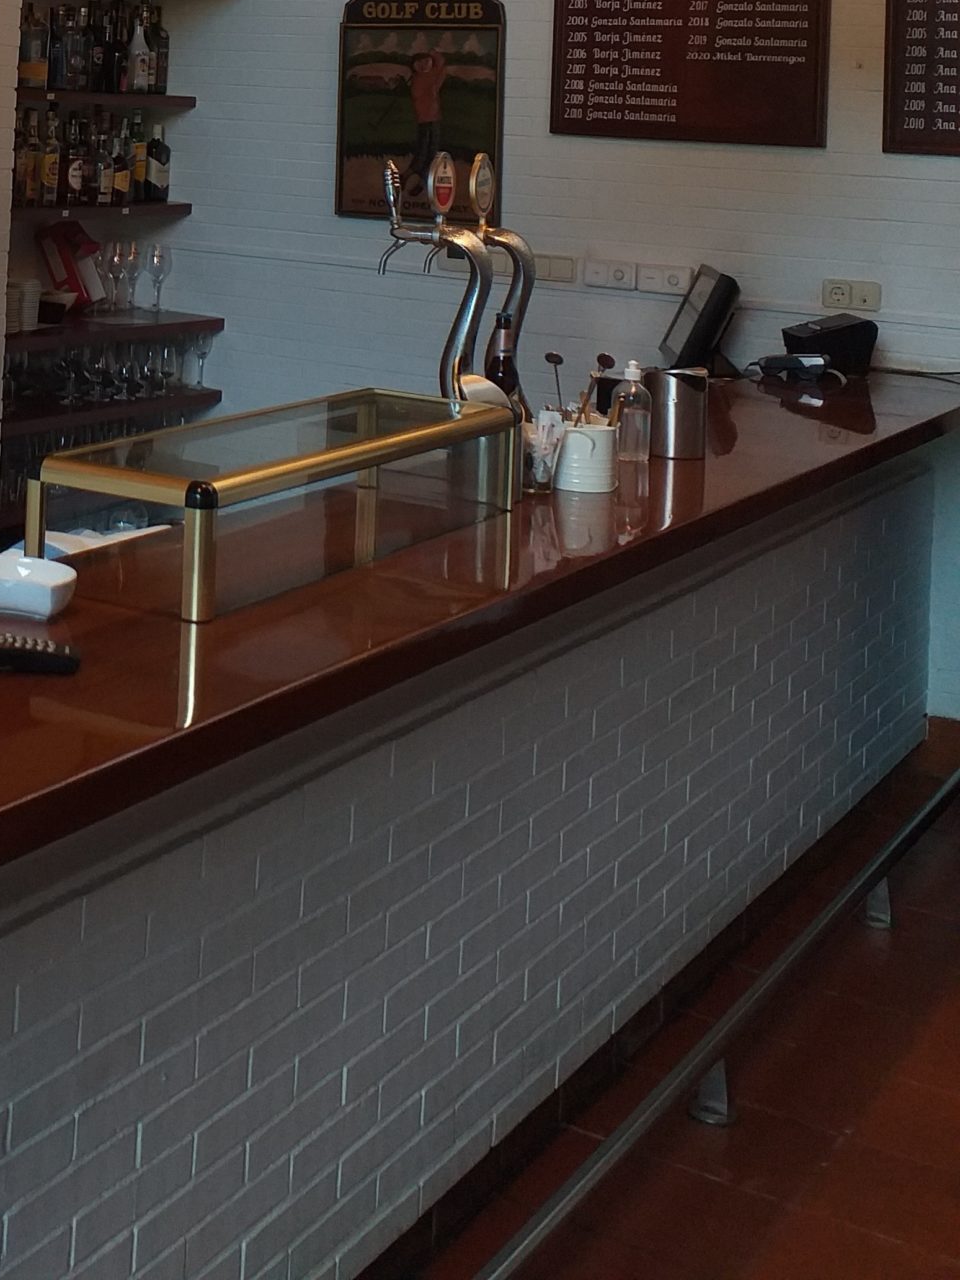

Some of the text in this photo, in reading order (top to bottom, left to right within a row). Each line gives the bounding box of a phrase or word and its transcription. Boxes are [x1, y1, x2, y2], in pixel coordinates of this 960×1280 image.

[362, 2, 484, 19] GOLF CLUB
[716, 1, 753, 14] Gonzalo
[935, 10, 958, 22] Ana
[590, 16, 628, 28] Gonzalo
[688, 17, 710, 26] 2018
[716, 17, 753, 30] Gonzalo
[934, 27, 958, 40] Ana
[594, 32, 620, 44] Borja
[714, 35, 752, 48] Gonzalo
[593, 48, 618, 61] Borja
[686, 52, 710, 60] 2020
[712, 51, 742, 60] Mikel
[934, 46, 958, 58] Ana
[593, 64, 618, 77] Borja
[934, 64, 957, 76] Ana
[588, 80, 624, 92] Gonzalo
[934, 82, 956, 94] Ana
[588, 93, 623, 106] Gonzalo
[932, 101, 956, 112] Ana
[586, 108, 622, 120] Gonzalo
[932, 118, 956, 130] Ana
